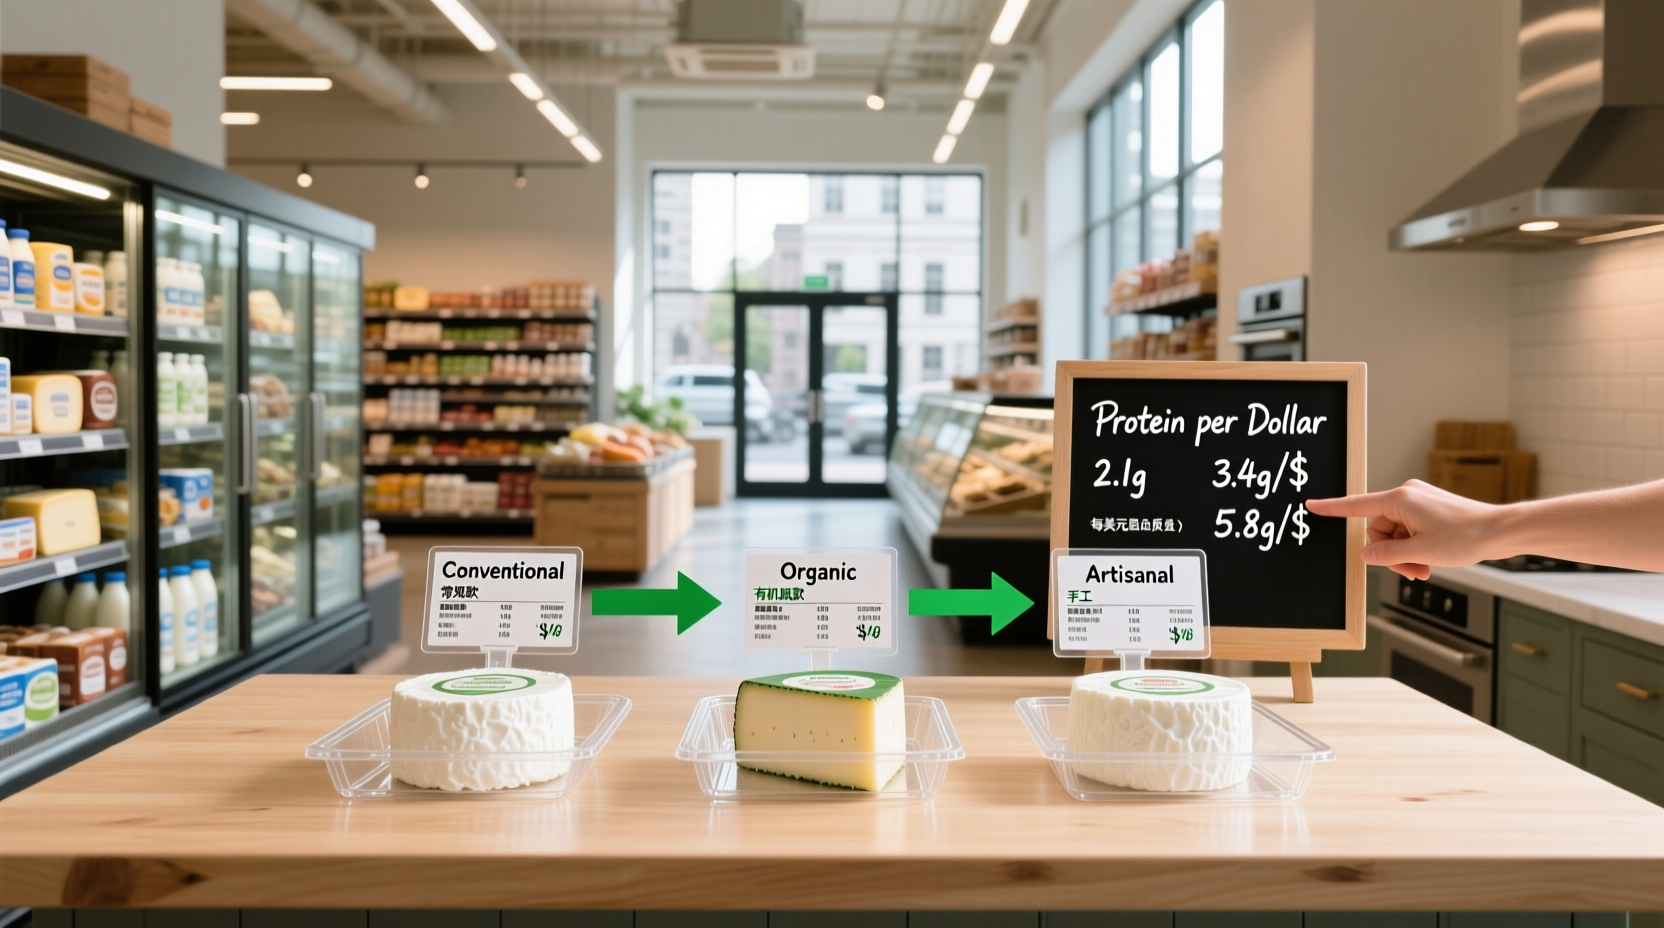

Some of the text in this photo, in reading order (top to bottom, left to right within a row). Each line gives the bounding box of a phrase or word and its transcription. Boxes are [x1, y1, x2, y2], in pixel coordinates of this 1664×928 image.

[1090, 399, 1328, 447] Protein per Dollar
[1093, 450, 1309, 500] 2.1g 3.4g/$
[1213, 502, 1311, 552] 5.8g/$
[442, 560, 565, 580] Conventional
[780, 561, 857, 586] Organic
[1085, 564, 1174, 584] Artisanal
[1067, 590, 1093, 603] 手工
